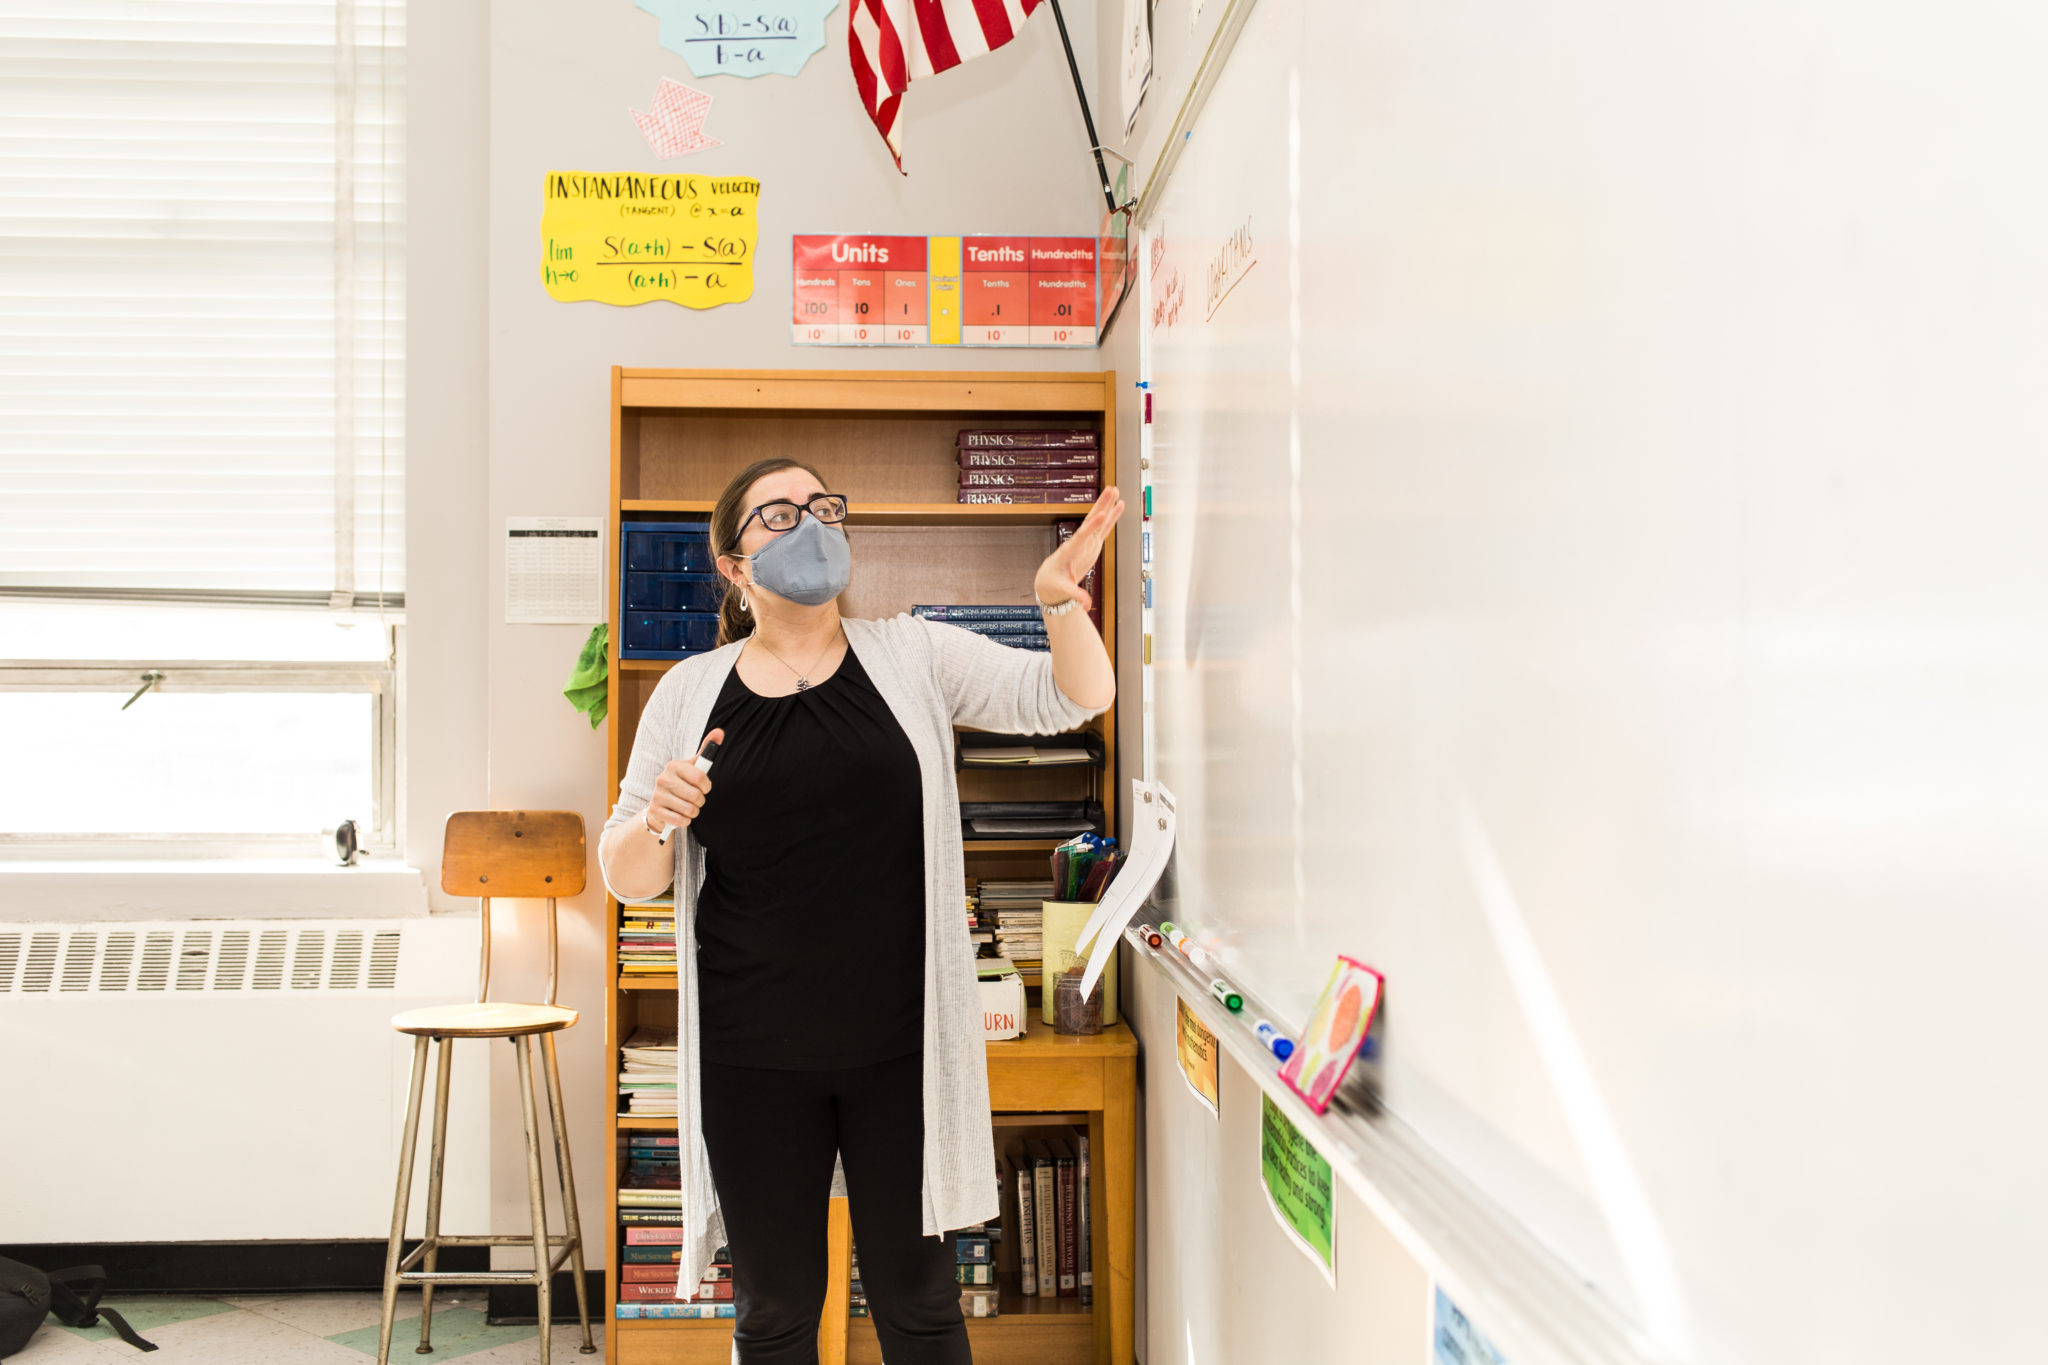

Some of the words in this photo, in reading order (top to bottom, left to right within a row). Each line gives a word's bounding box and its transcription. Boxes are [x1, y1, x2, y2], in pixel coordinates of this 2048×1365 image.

[550, 175, 698, 200] INSTANTANEOUS
[711, 181, 760, 197] VELOCITY
[549, 238, 573, 261] lim
[831, 242, 889, 263] Units
[967, 246, 1025, 262] Tenths
[1032, 249, 1094, 260] Hundredths
[796, 278, 836, 286] Hundreds
[852, 278, 871, 286] Tens
[895, 279, 916, 287] Ones
[982, 280, 1010, 288] Tenths
[1038, 280, 1086, 288] Hundredths
[805, 303, 828, 314] 100
[855, 303, 869, 314] 10
[903, 303, 908, 315] 1
[991, 304, 1001, 316] .1
[1053, 304, 1072, 316] .01
[968, 434, 1014, 446] PHYSICS
[969, 454, 1016, 466] PHYSICS
[968, 474, 1015, 485] PHYSICS
[966, 493, 1013, 504] PHYSICS
[638, 1286, 672, 1295] WICKED
